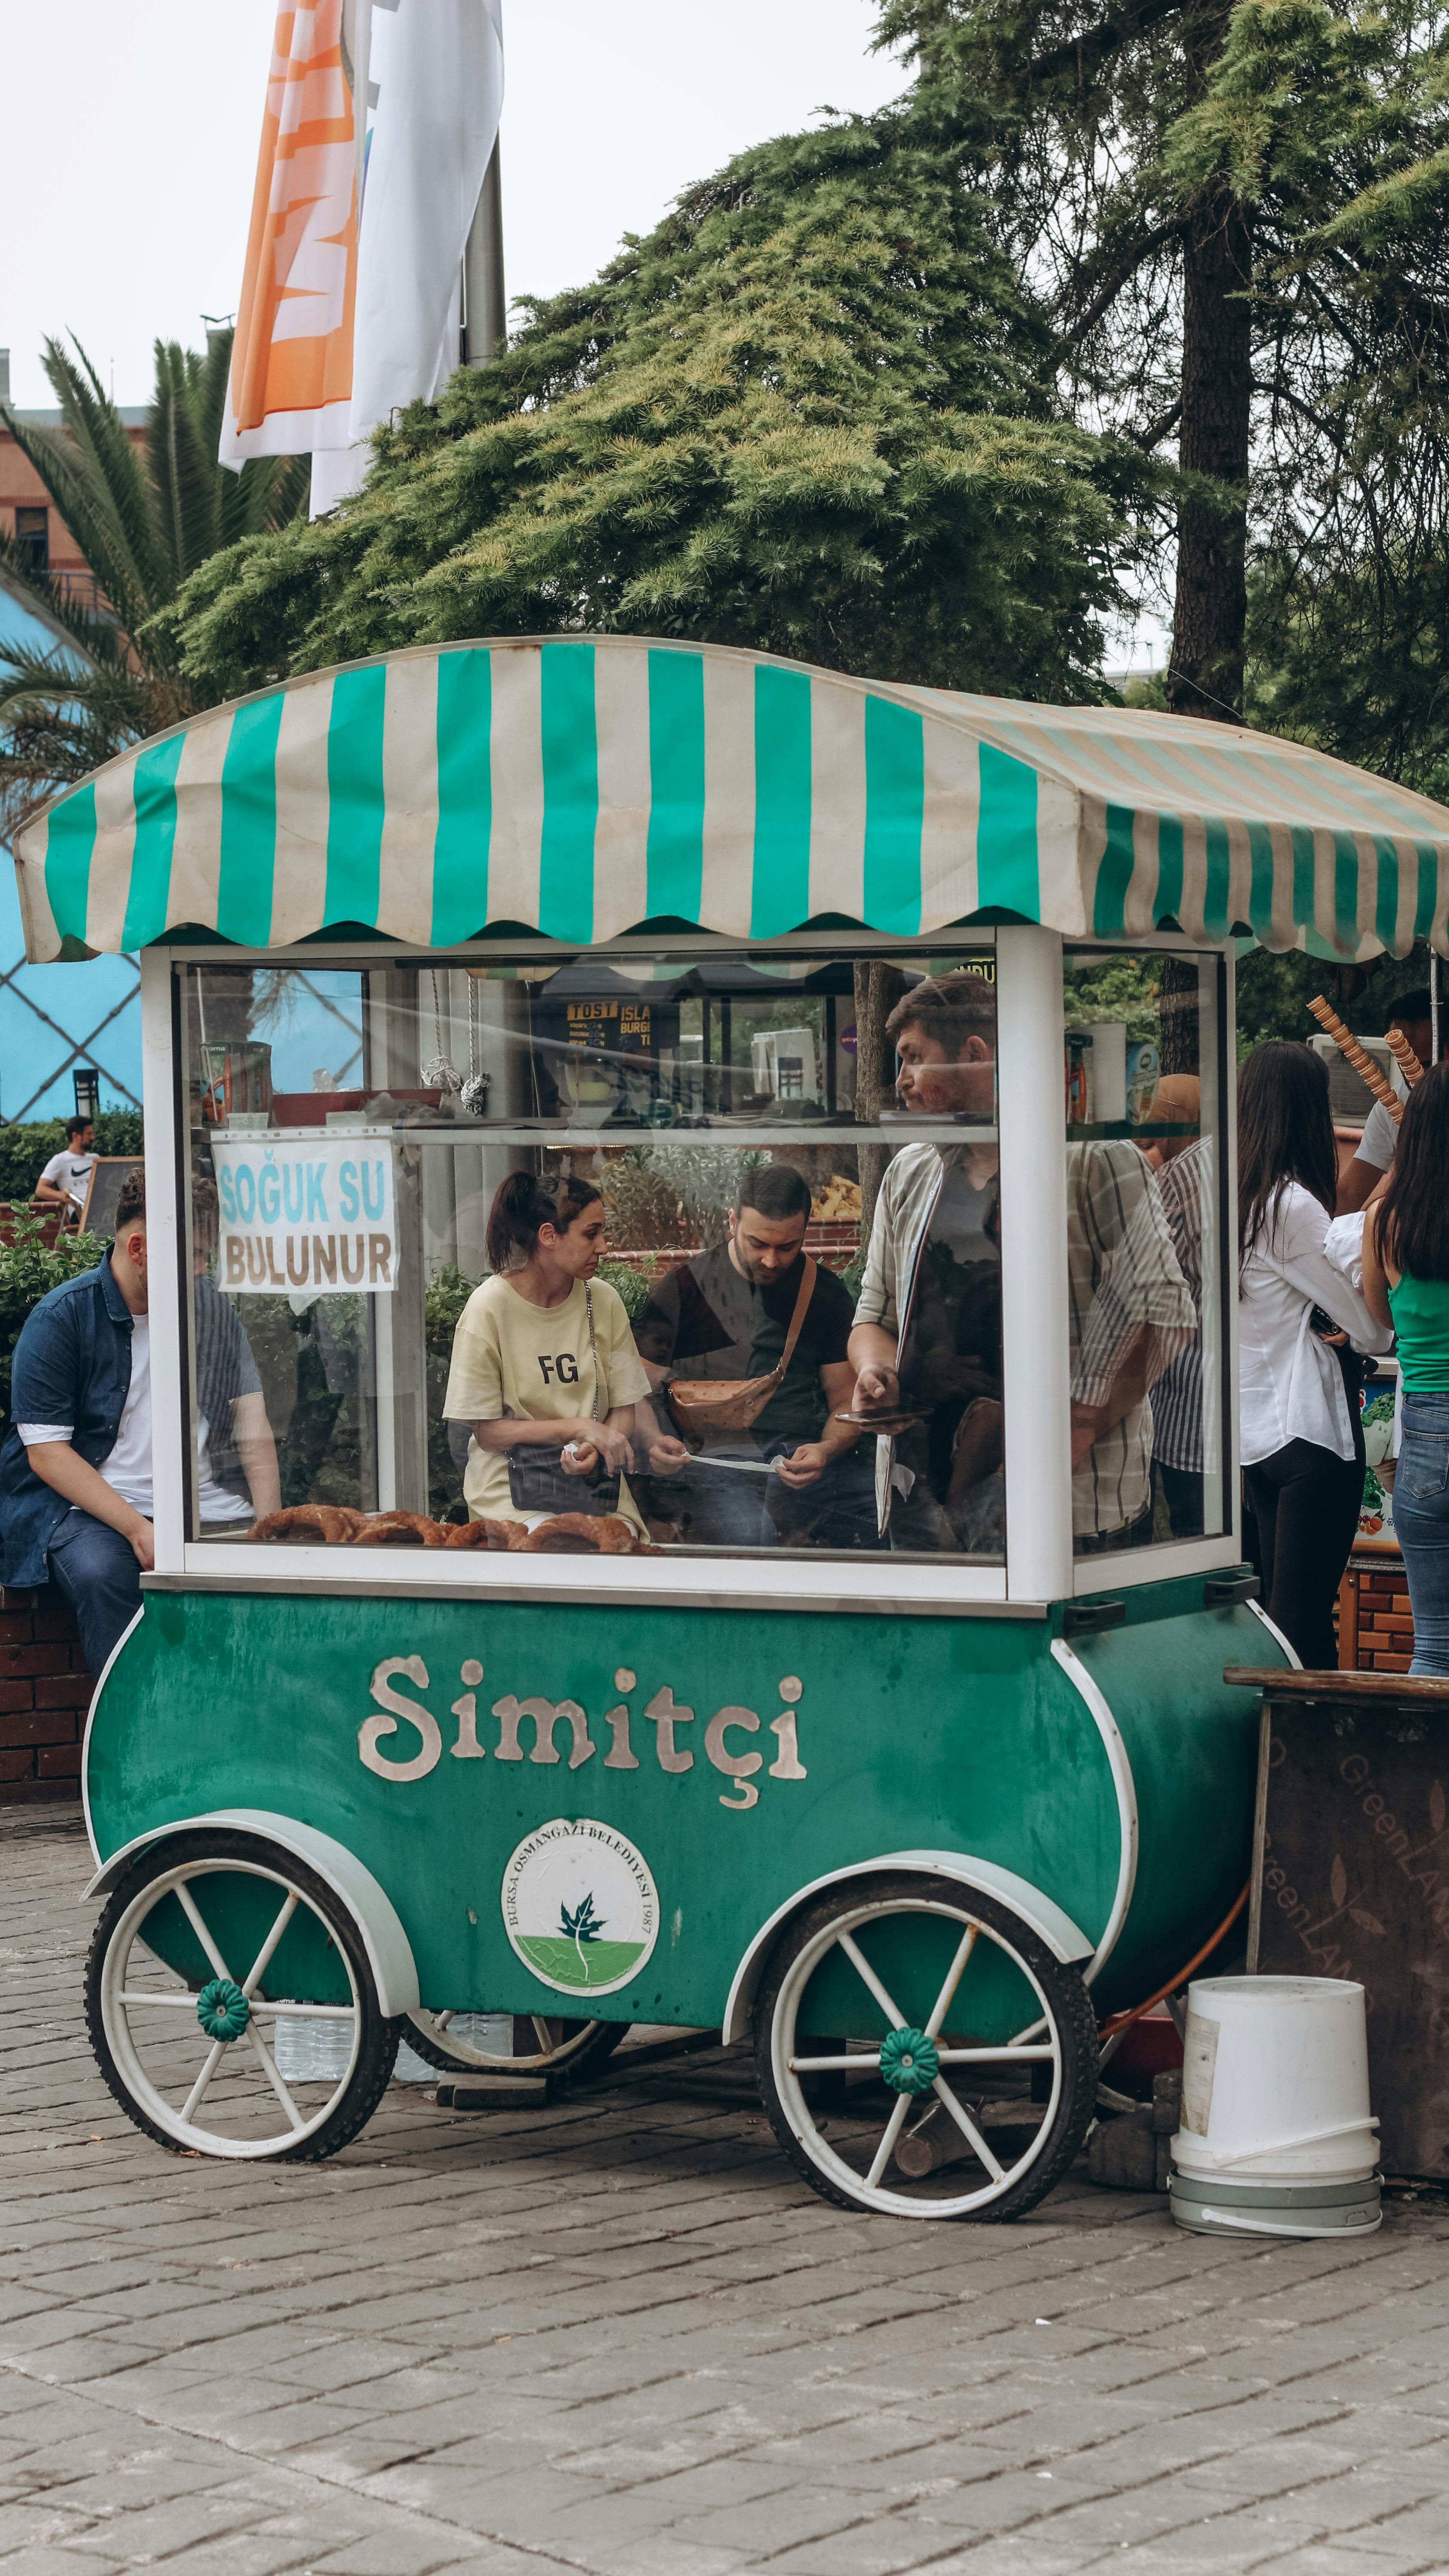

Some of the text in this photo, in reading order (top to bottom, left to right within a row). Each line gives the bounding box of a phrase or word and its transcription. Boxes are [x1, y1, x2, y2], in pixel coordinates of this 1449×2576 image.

[573, 1003, 612, 1019] TOST
[220, 1148, 385, 1225] SOĞUK SU
[226, 1233, 392, 1286] BULUNUR
[538, 1353, 579, 1384] FG
[357, 1654, 807, 1810] Simitçi
[507, 1823, 653, 1934] BURSA OSMANGAZİ BELEDİYESİ 1987
